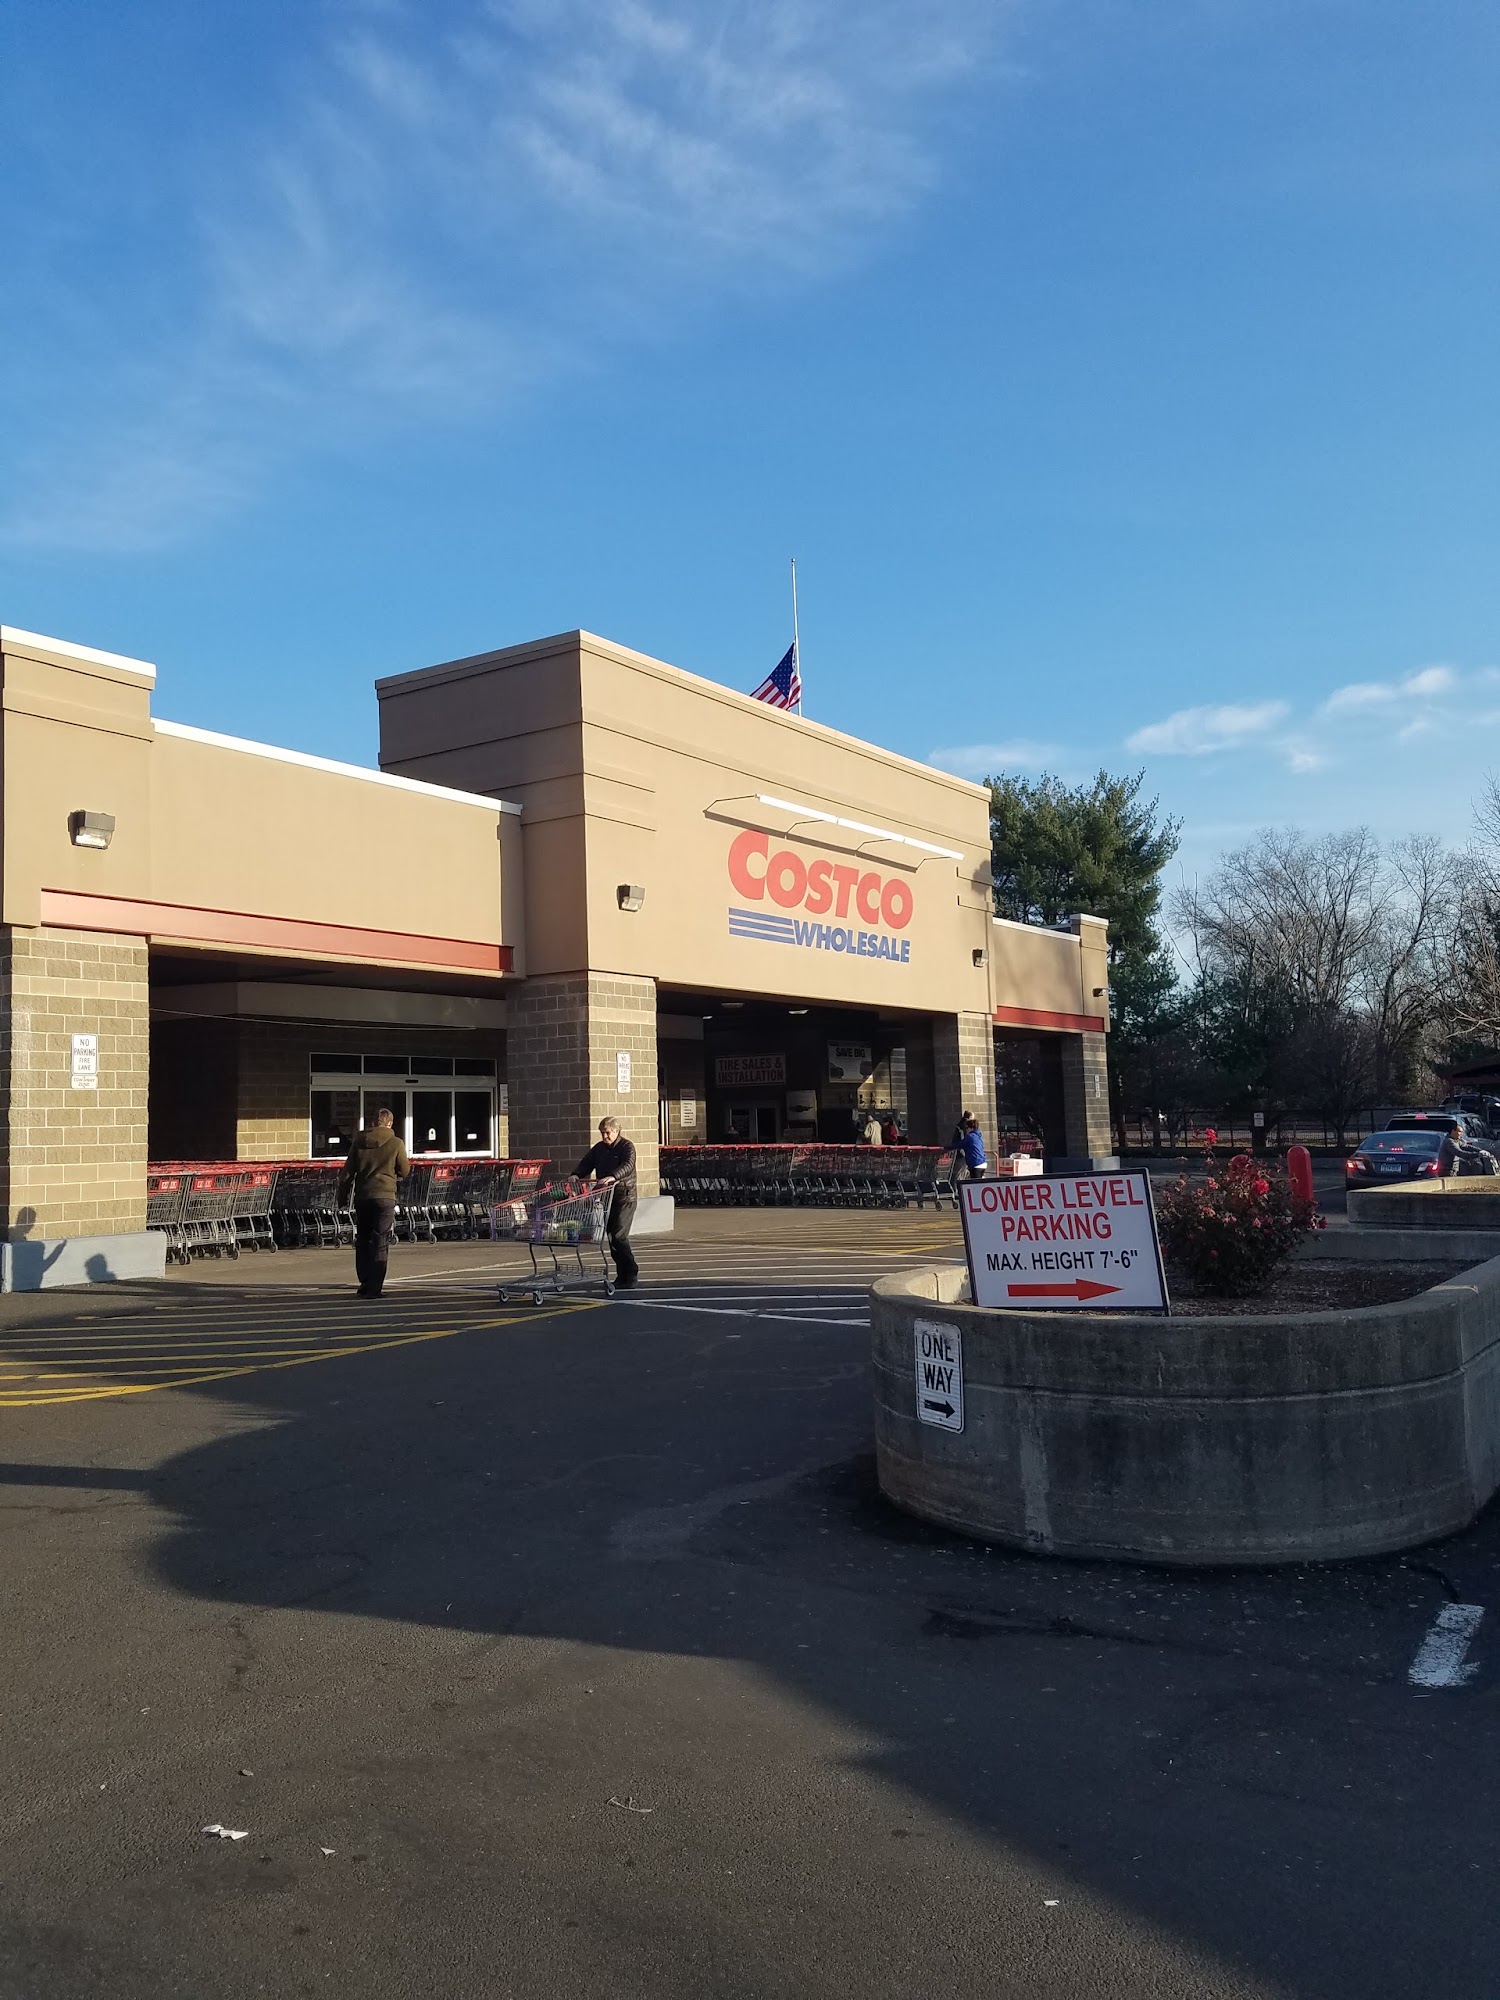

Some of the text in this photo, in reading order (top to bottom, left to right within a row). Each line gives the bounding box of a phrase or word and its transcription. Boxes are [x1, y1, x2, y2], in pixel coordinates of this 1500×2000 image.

[728, 829, 913, 929] COSTCO
[794, 919, 910, 963] WHOLESALE
[73, 1048, 96, 1057] PARKING
[79, 1038, 90, 1047] NO
[719, 1056, 783, 1071] TIRE SALES &
[719, 1069, 784, 1083] INSTALLATION
[967, 1179, 1144, 1213] LOWER LEVEL
[1001, 1211, 1112, 1242] PARKING
[986, 1249, 1139, 1271] MAX. HEIGHT 7'-6"
[921, 1331, 955, 1363] ONE
[923, 1362, 954, 1394] WAY
